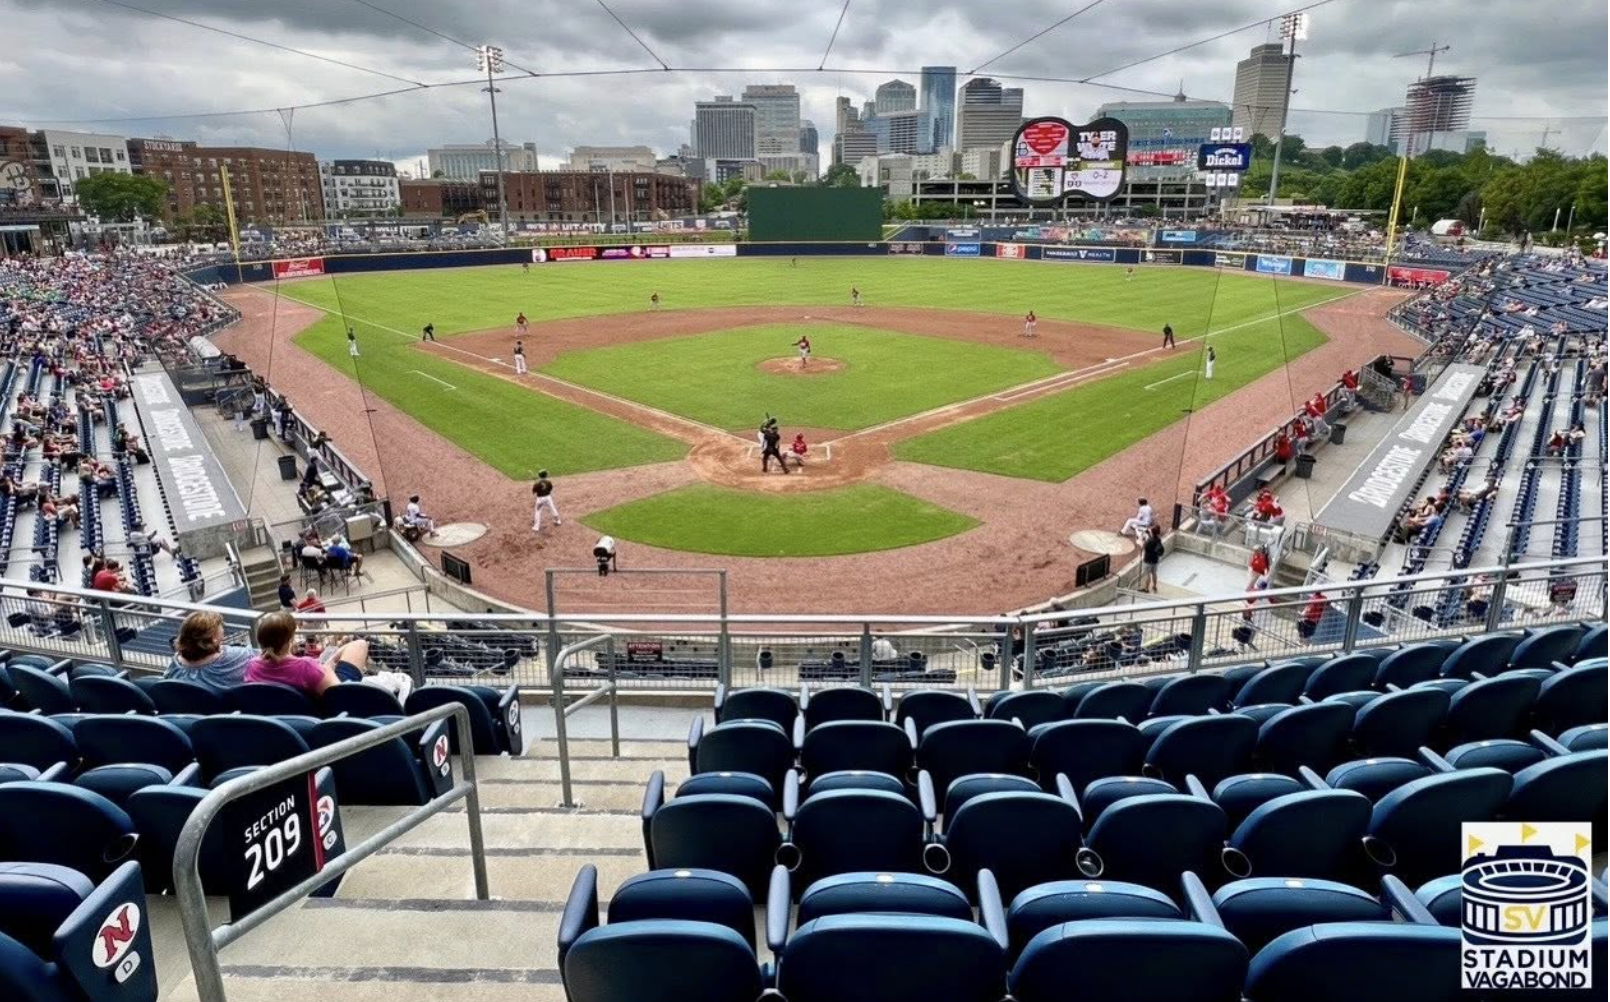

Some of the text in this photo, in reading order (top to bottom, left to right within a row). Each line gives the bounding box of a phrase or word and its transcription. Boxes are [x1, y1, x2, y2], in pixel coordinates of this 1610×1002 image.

[1079, 131, 1116, 142] TYER
[1076, 141, 1116, 152] WTE
[1205, 154, 1243, 166] Dickel
[244, 794, 295, 844] SECTION
[244, 812, 301, 891] 209
[99, 905, 135, 963] N
[122, 960, 133, 974] D
